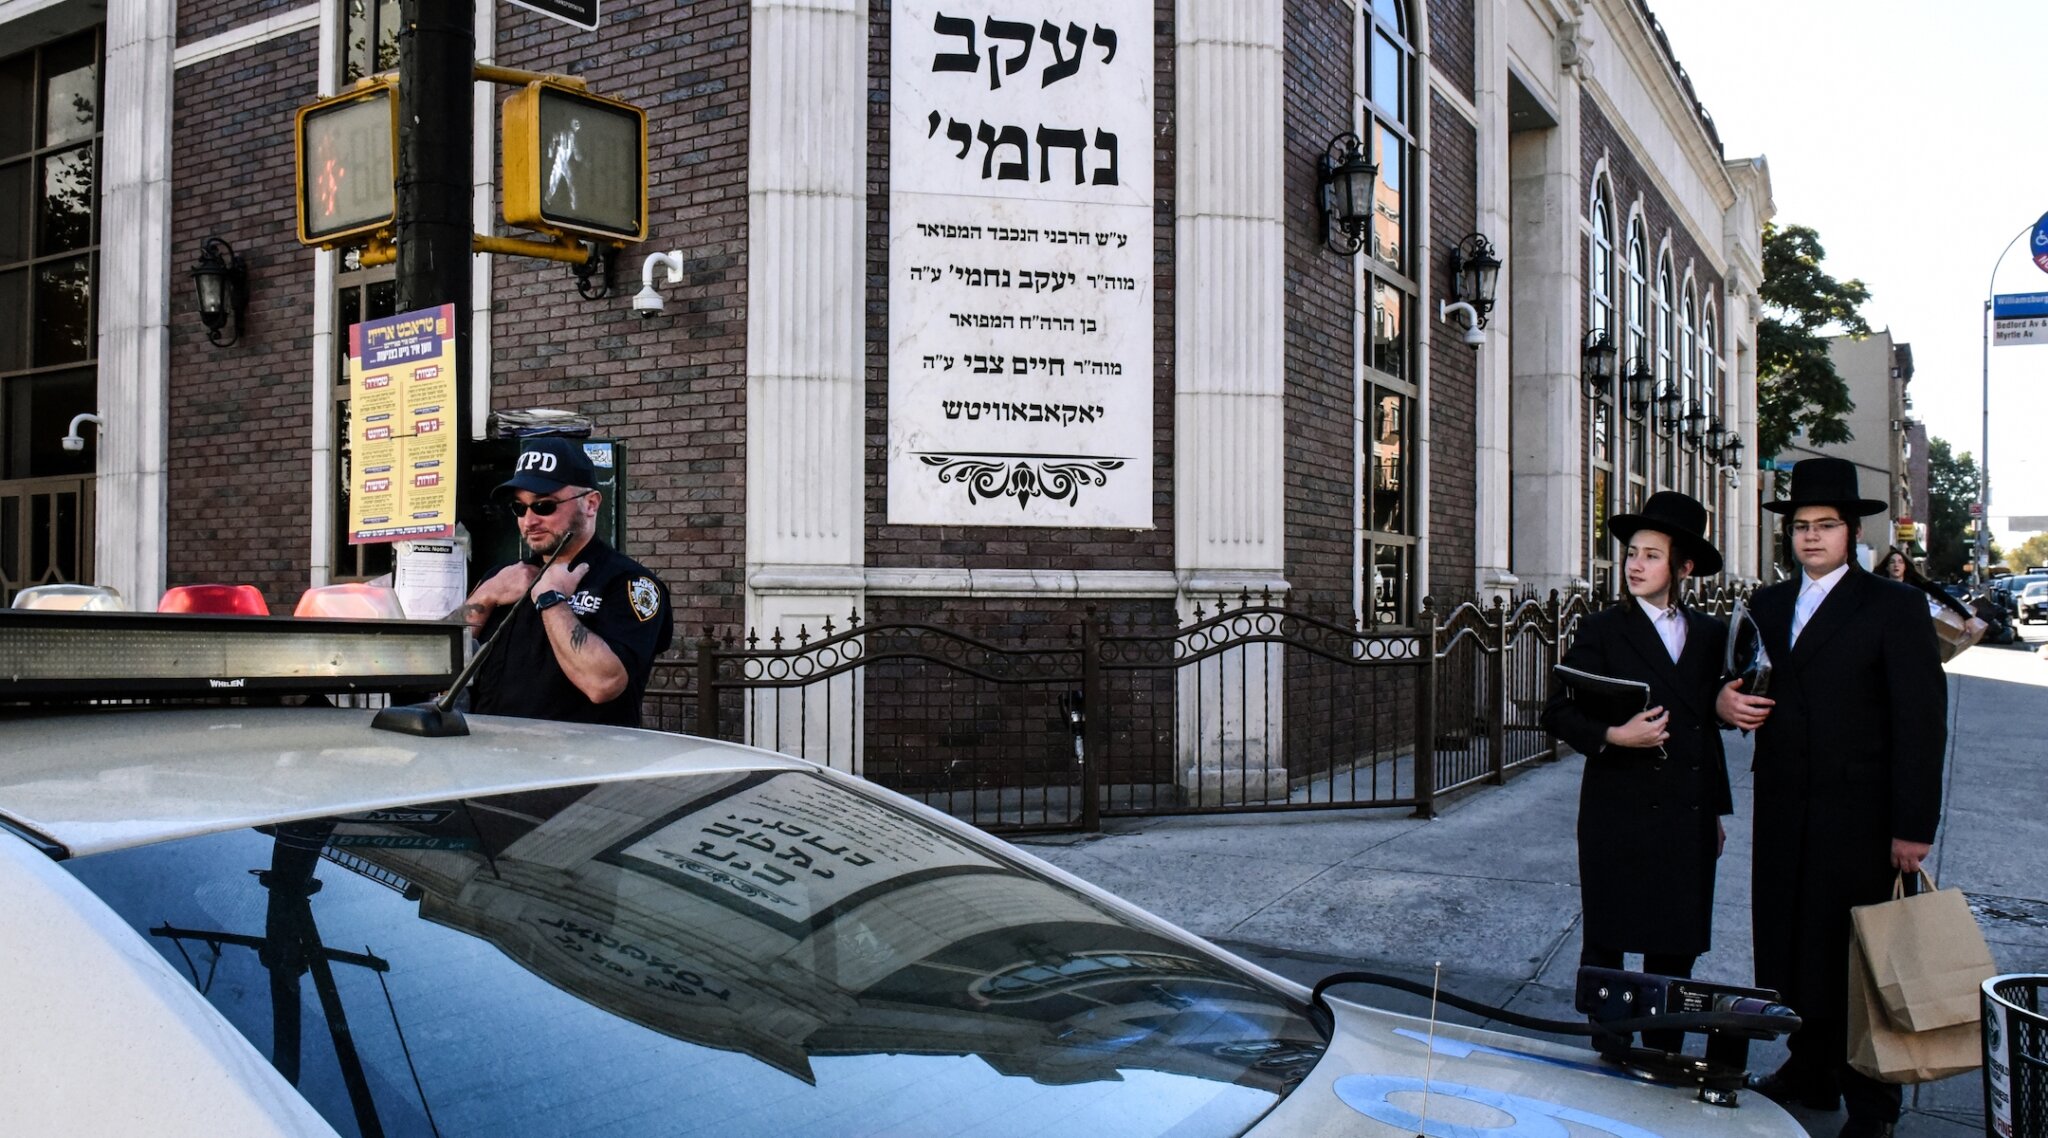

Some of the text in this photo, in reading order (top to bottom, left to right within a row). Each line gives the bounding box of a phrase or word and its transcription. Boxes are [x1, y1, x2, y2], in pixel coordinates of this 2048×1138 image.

[932, 11, 1118, 91] יעקב
[928, 109, 1119, 186] נחמי'
[917, 222, 982, 239] המפואר
[987, 226, 1039, 242] הנכבד
[1044, 229, 1090, 245] הרבני
[949, 264, 1010, 288] נחמי'
[1018, 268, 1076, 293] יעקב
[949, 313, 1014, 329] המפואר
[1080, 319, 1097, 335] בן
[1996, 321, 2026, 329] Bedford
[2041, 319, 2047, 327] &
[1996, 332, 2021, 340] Myrtle
[963, 354, 1004, 374] צבי
[1012, 356, 1065, 376] חיים
[942, 400, 1105, 427] יאקאבאוויטש
[514, 451, 557, 472] YPD
[567, 592, 602, 609] OLICE
[209, 679, 245, 688] WHELEN
